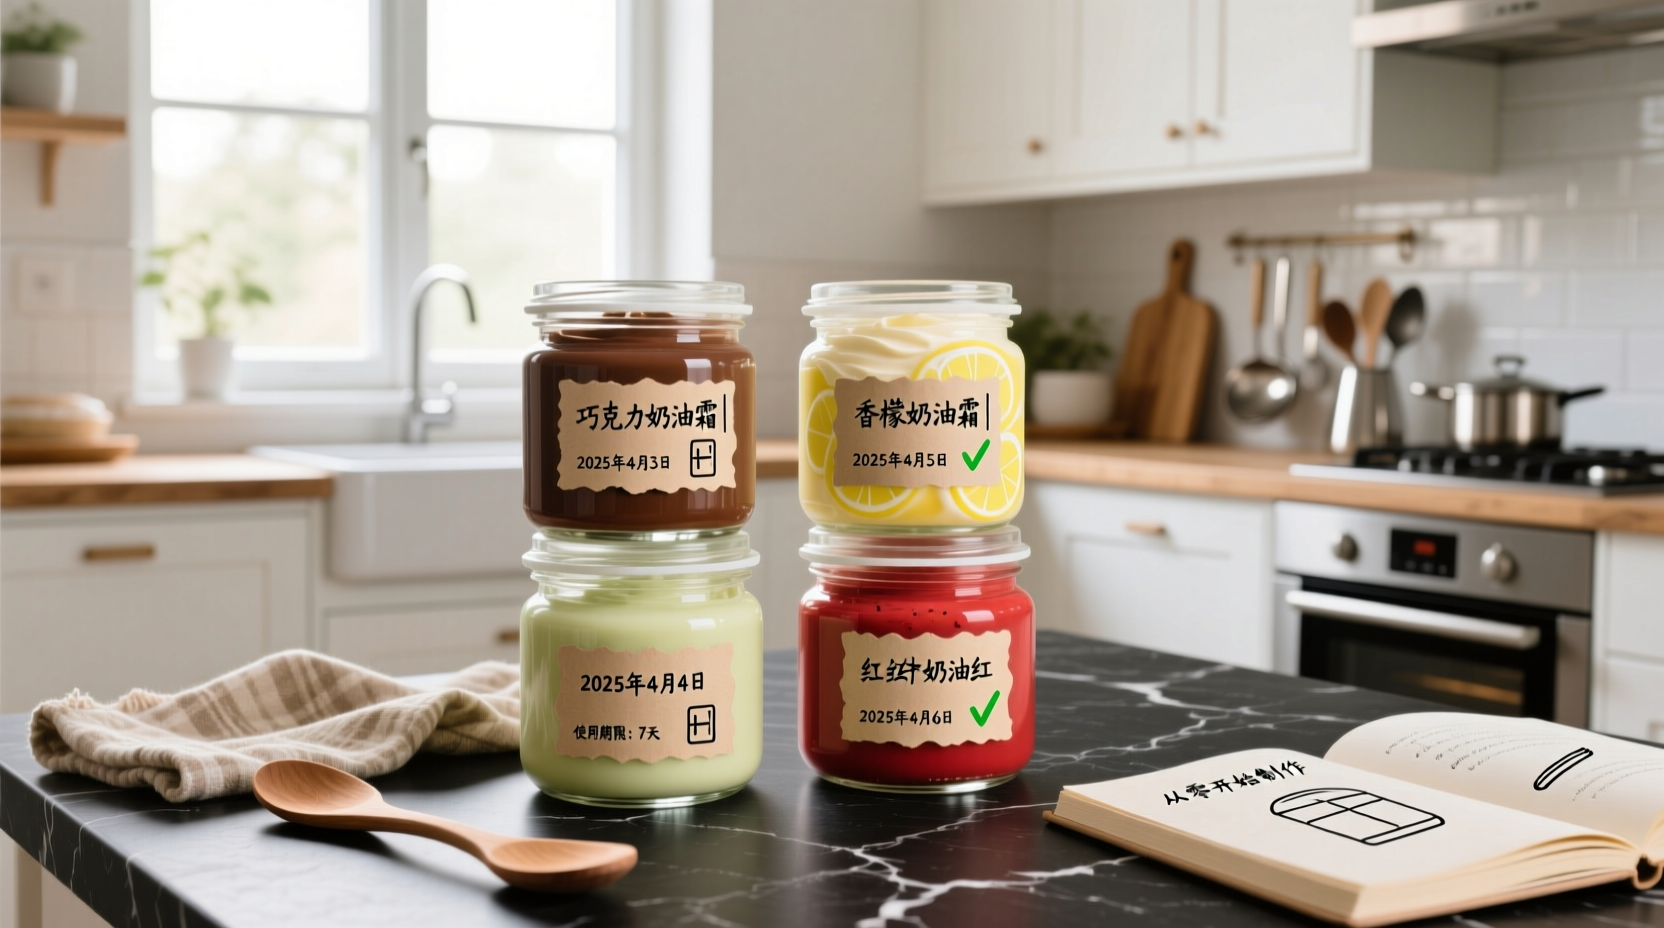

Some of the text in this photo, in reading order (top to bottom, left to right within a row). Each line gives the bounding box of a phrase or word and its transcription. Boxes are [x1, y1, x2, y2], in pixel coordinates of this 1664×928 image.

[576, 400, 717, 430] 巧克力奶油霜
[577, 454, 669, 471] 2025年4月3日
[853, 452, 946, 468] 2025年4月5日
[581, 672, 703, 696] 2025年4月4日
[860, 710, 951, 725] 2025年4月6日
